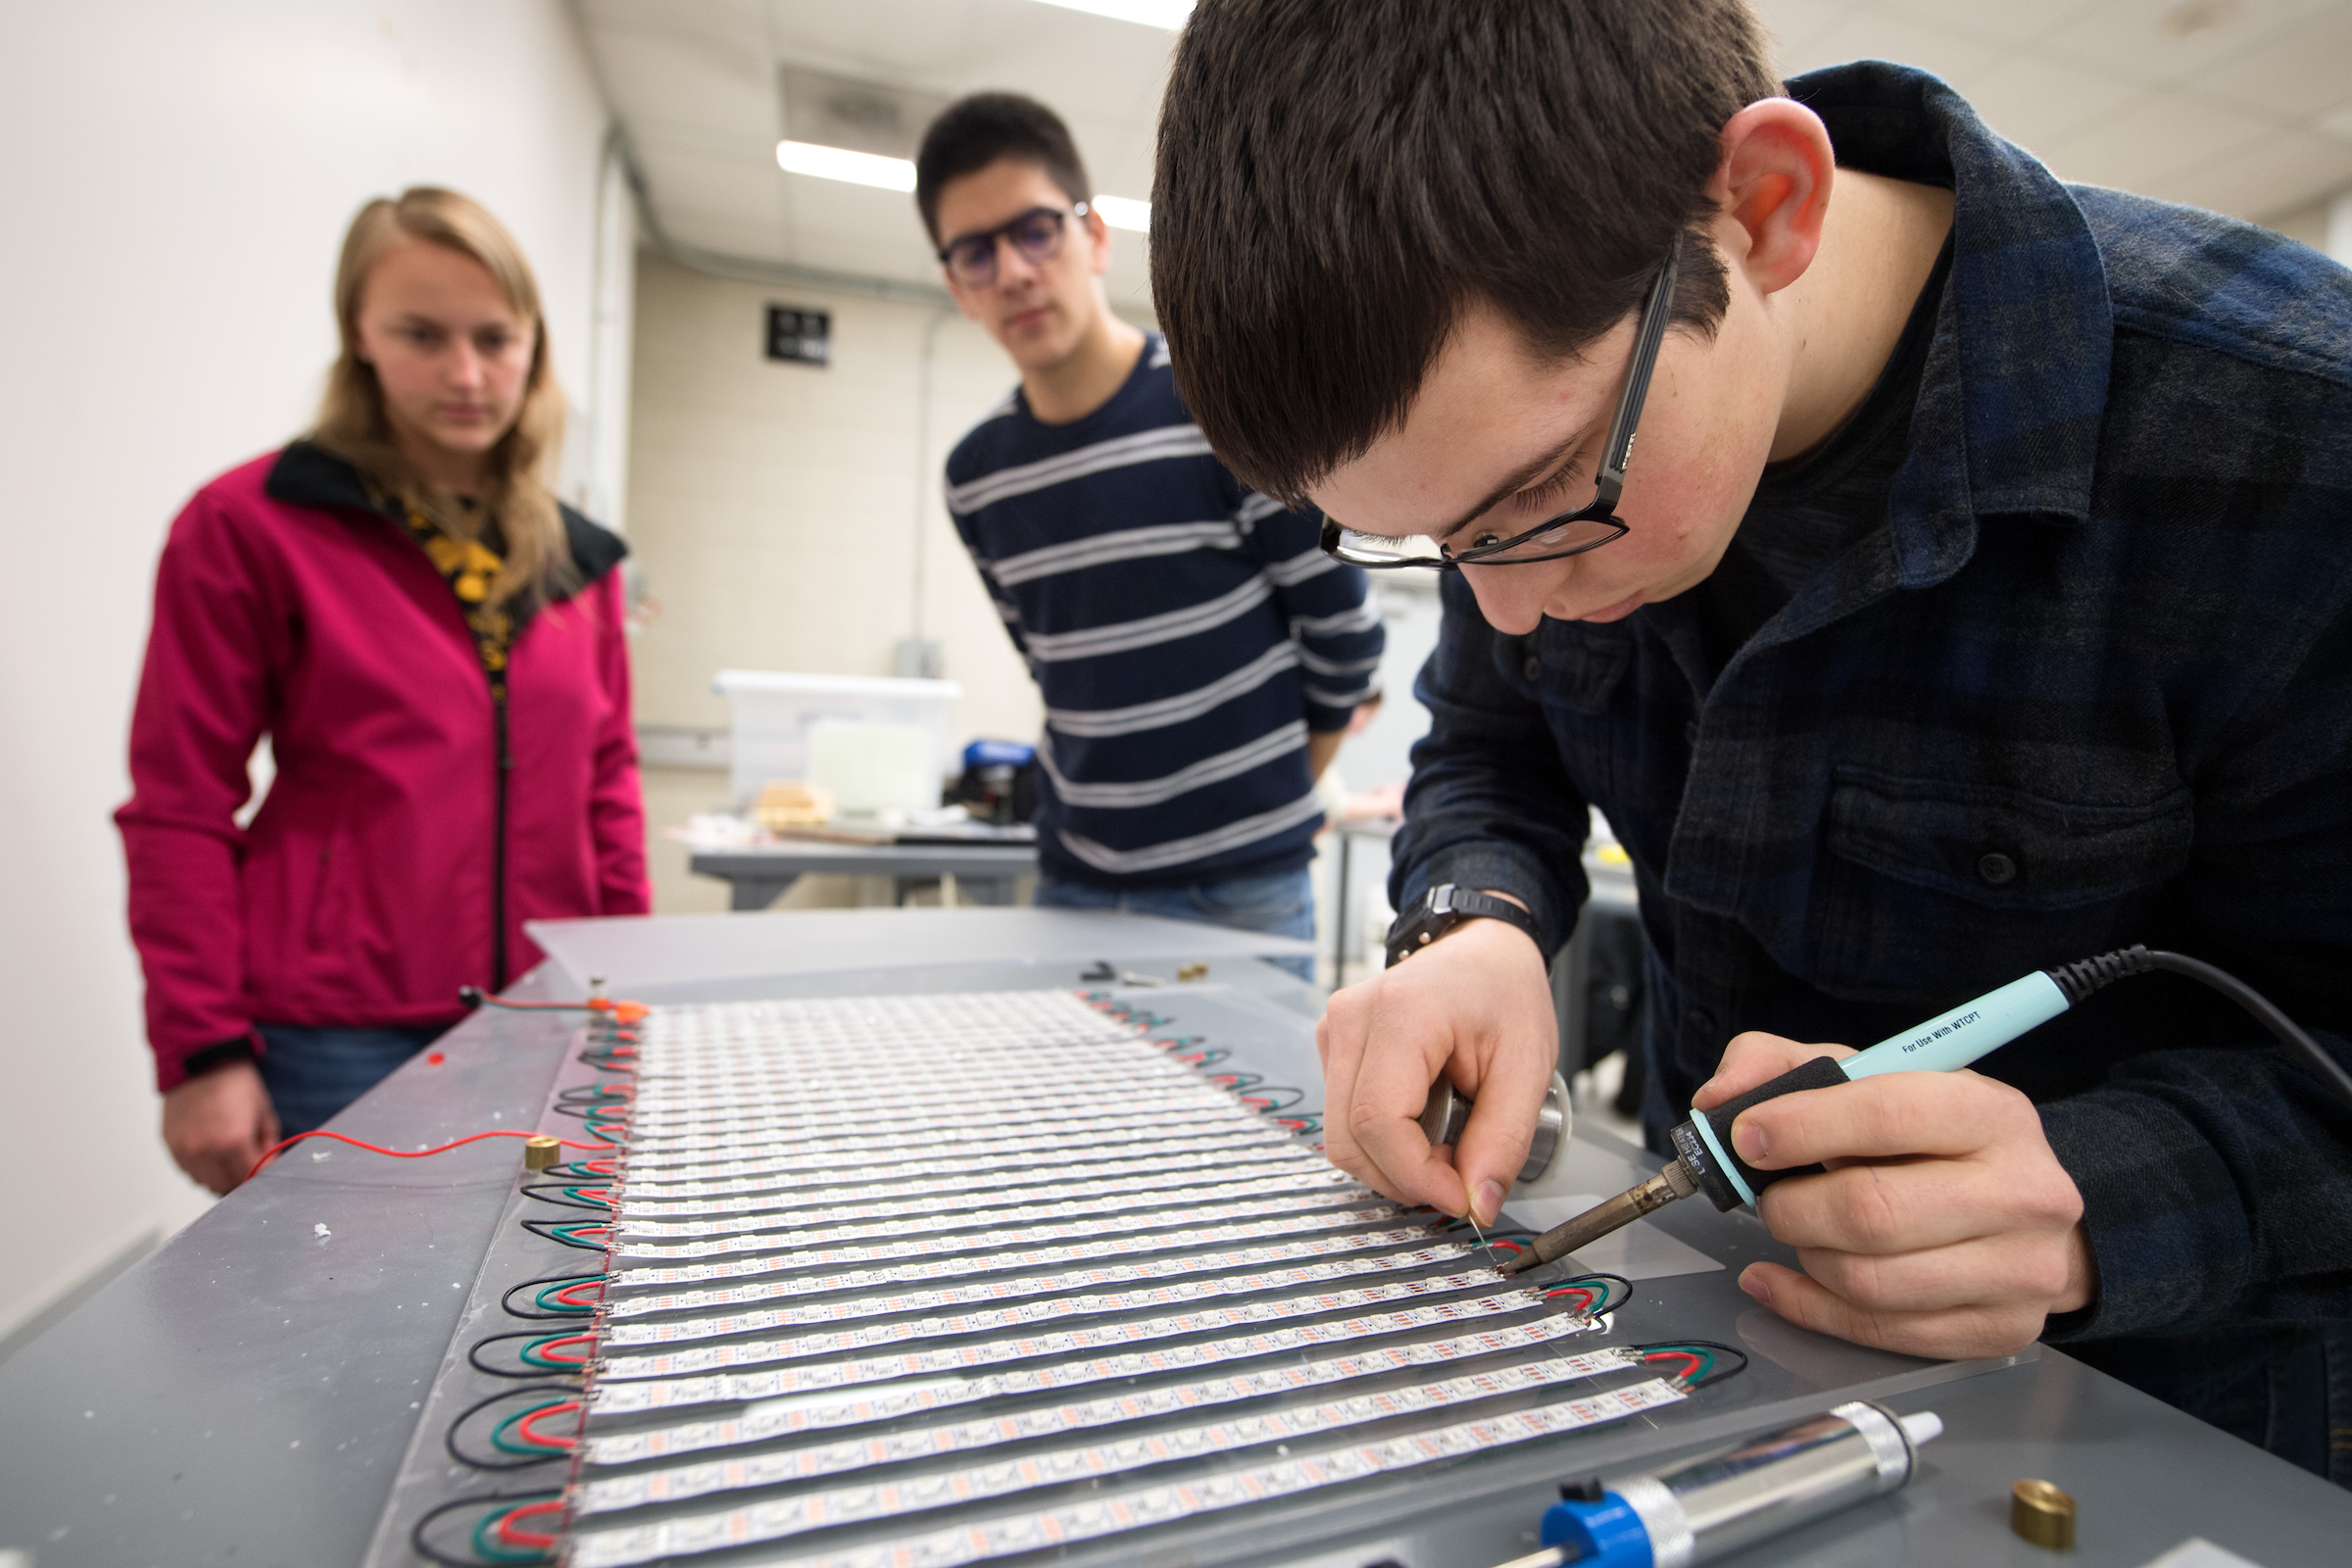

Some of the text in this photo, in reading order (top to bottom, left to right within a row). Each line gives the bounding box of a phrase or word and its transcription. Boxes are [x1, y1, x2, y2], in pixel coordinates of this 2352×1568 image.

[1902, 1010, 1982, 1054] For Use With WTCPT
